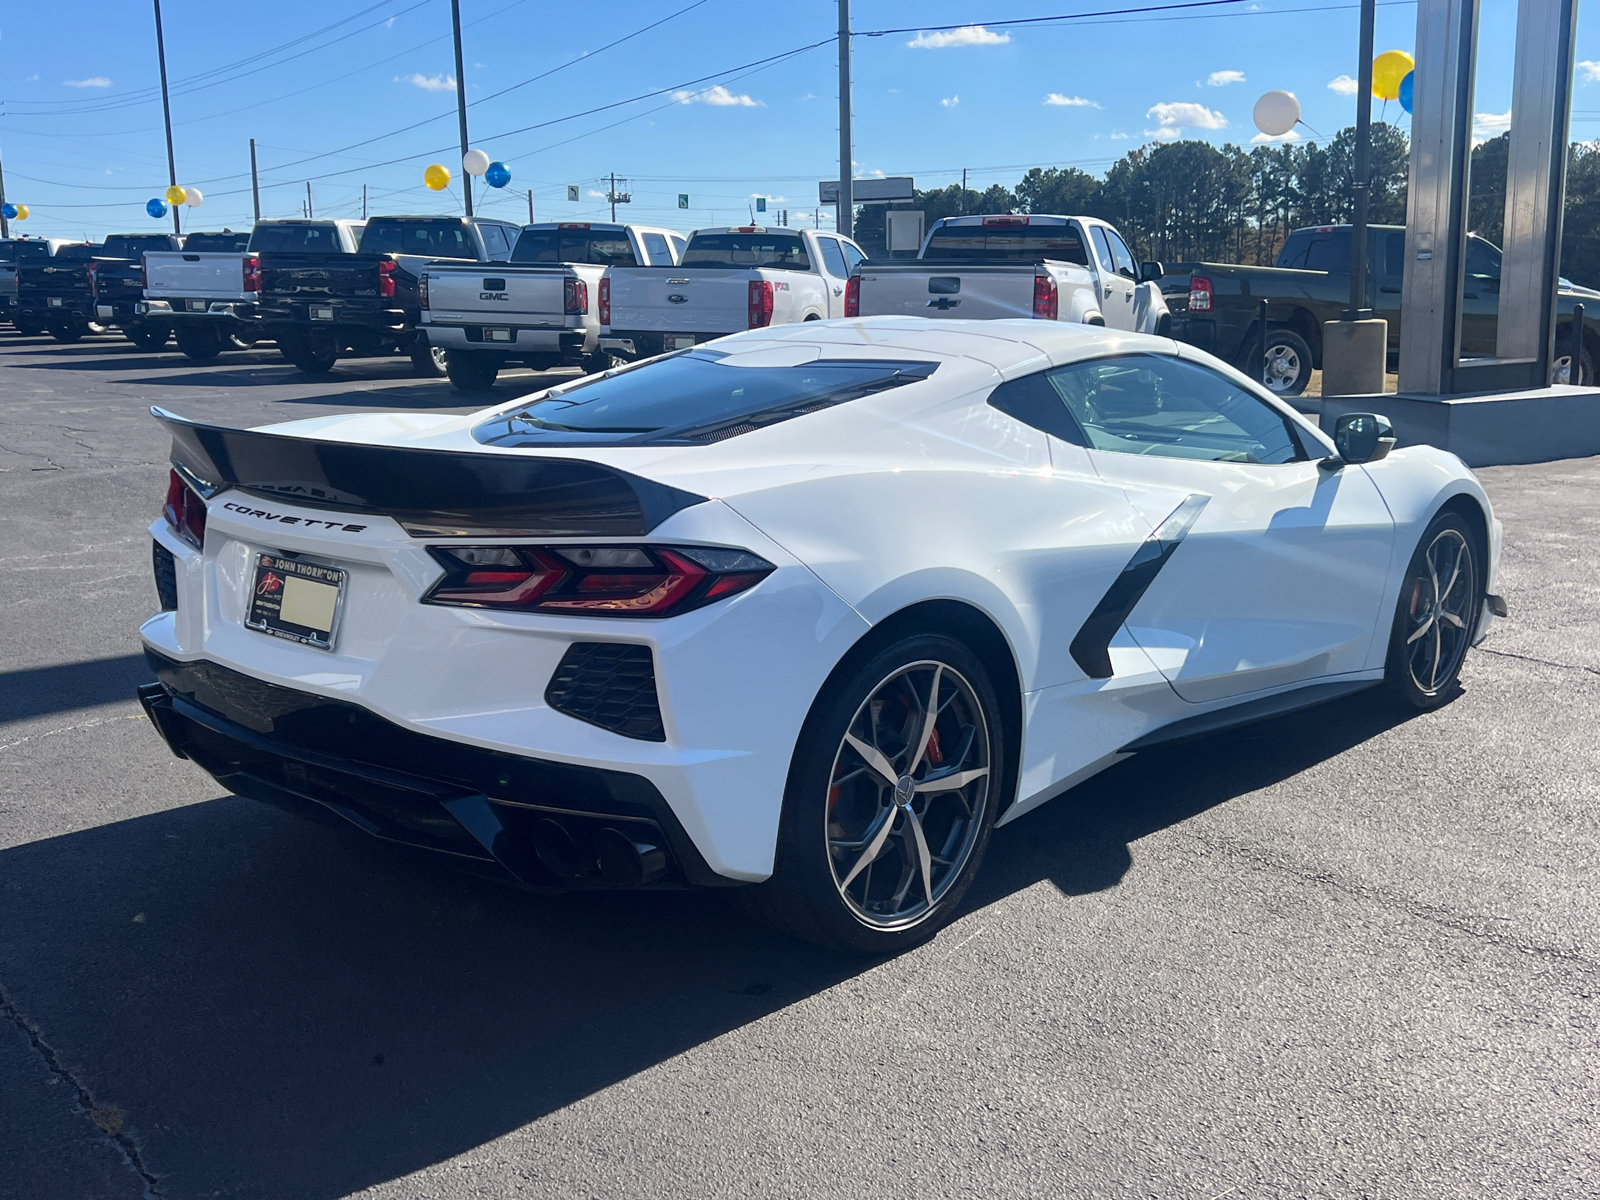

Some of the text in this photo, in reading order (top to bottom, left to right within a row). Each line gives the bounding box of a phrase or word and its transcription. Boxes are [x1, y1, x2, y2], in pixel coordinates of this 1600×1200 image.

[479, 292, 510, 302] GMC
[223, 502, 367, 533] CORVETTE
[275, 559, 296, 572] JOHN
